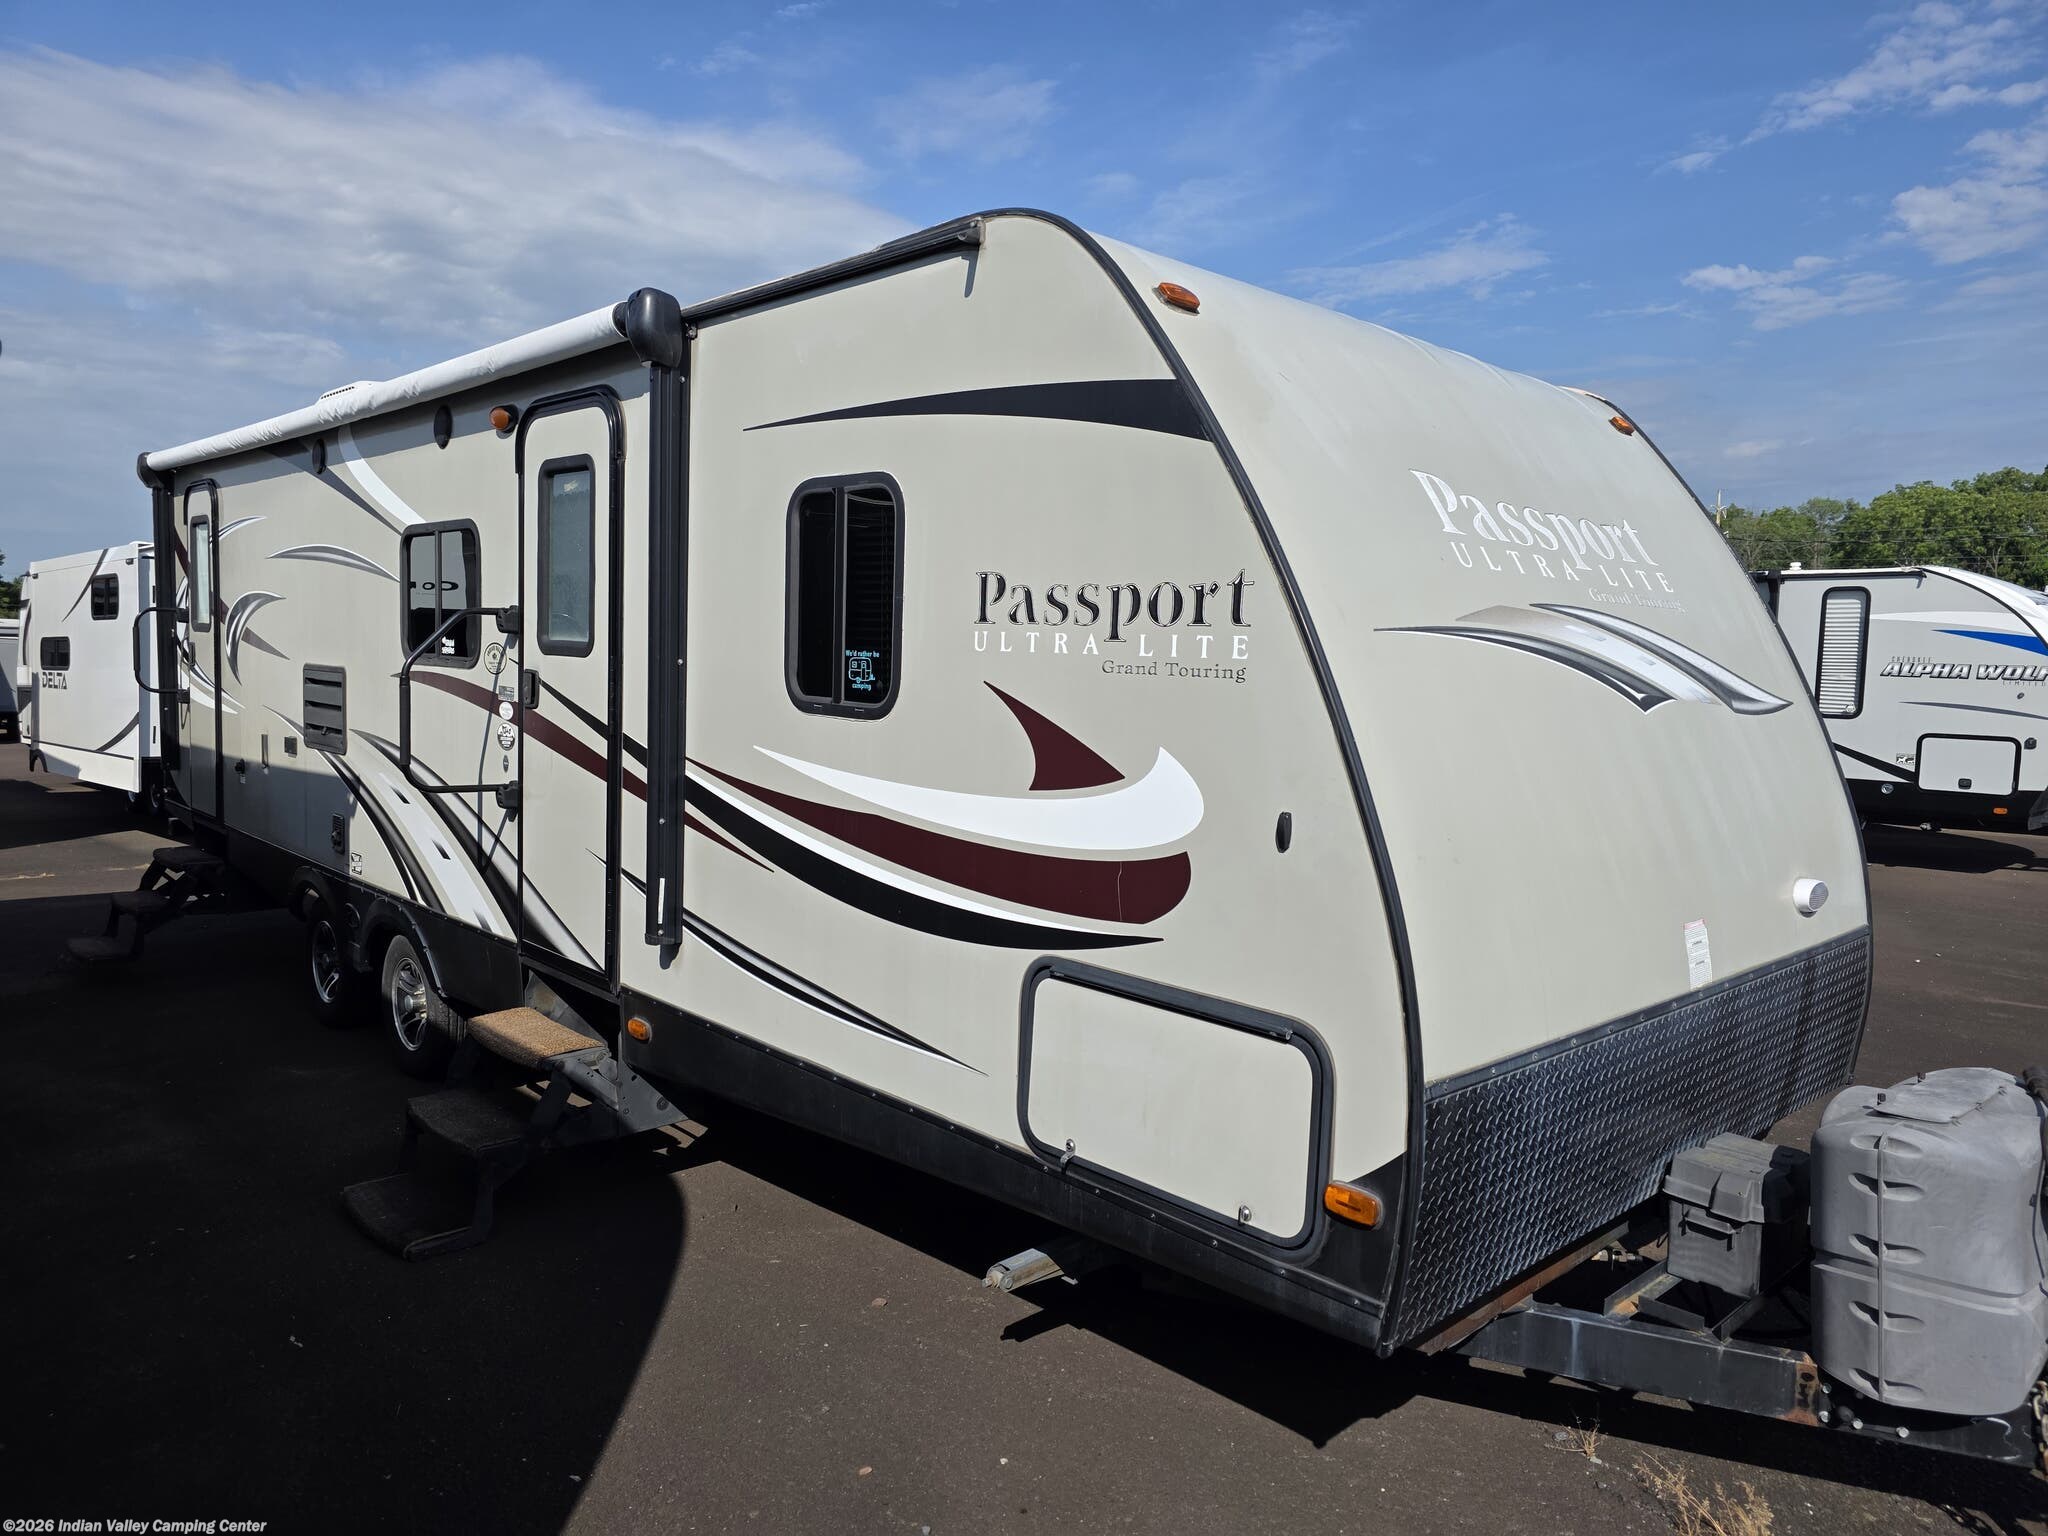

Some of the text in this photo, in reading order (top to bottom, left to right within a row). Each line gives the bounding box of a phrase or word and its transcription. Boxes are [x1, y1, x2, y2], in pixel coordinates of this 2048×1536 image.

[1408, 468, 1659, 570] Passport
[1450, 541, 1674, 592] ULTRA LITE
[974, 568, 1255, 642] Passport
[974, 631, 1249, 660] ULTRA LITE
[42, 671, 68, 690] DELTA
[1101, 660, 1247, 684] Grand Touring
[1880, 661, 1972, 679] ALPHA
[852, 682, 871, 691] camping
